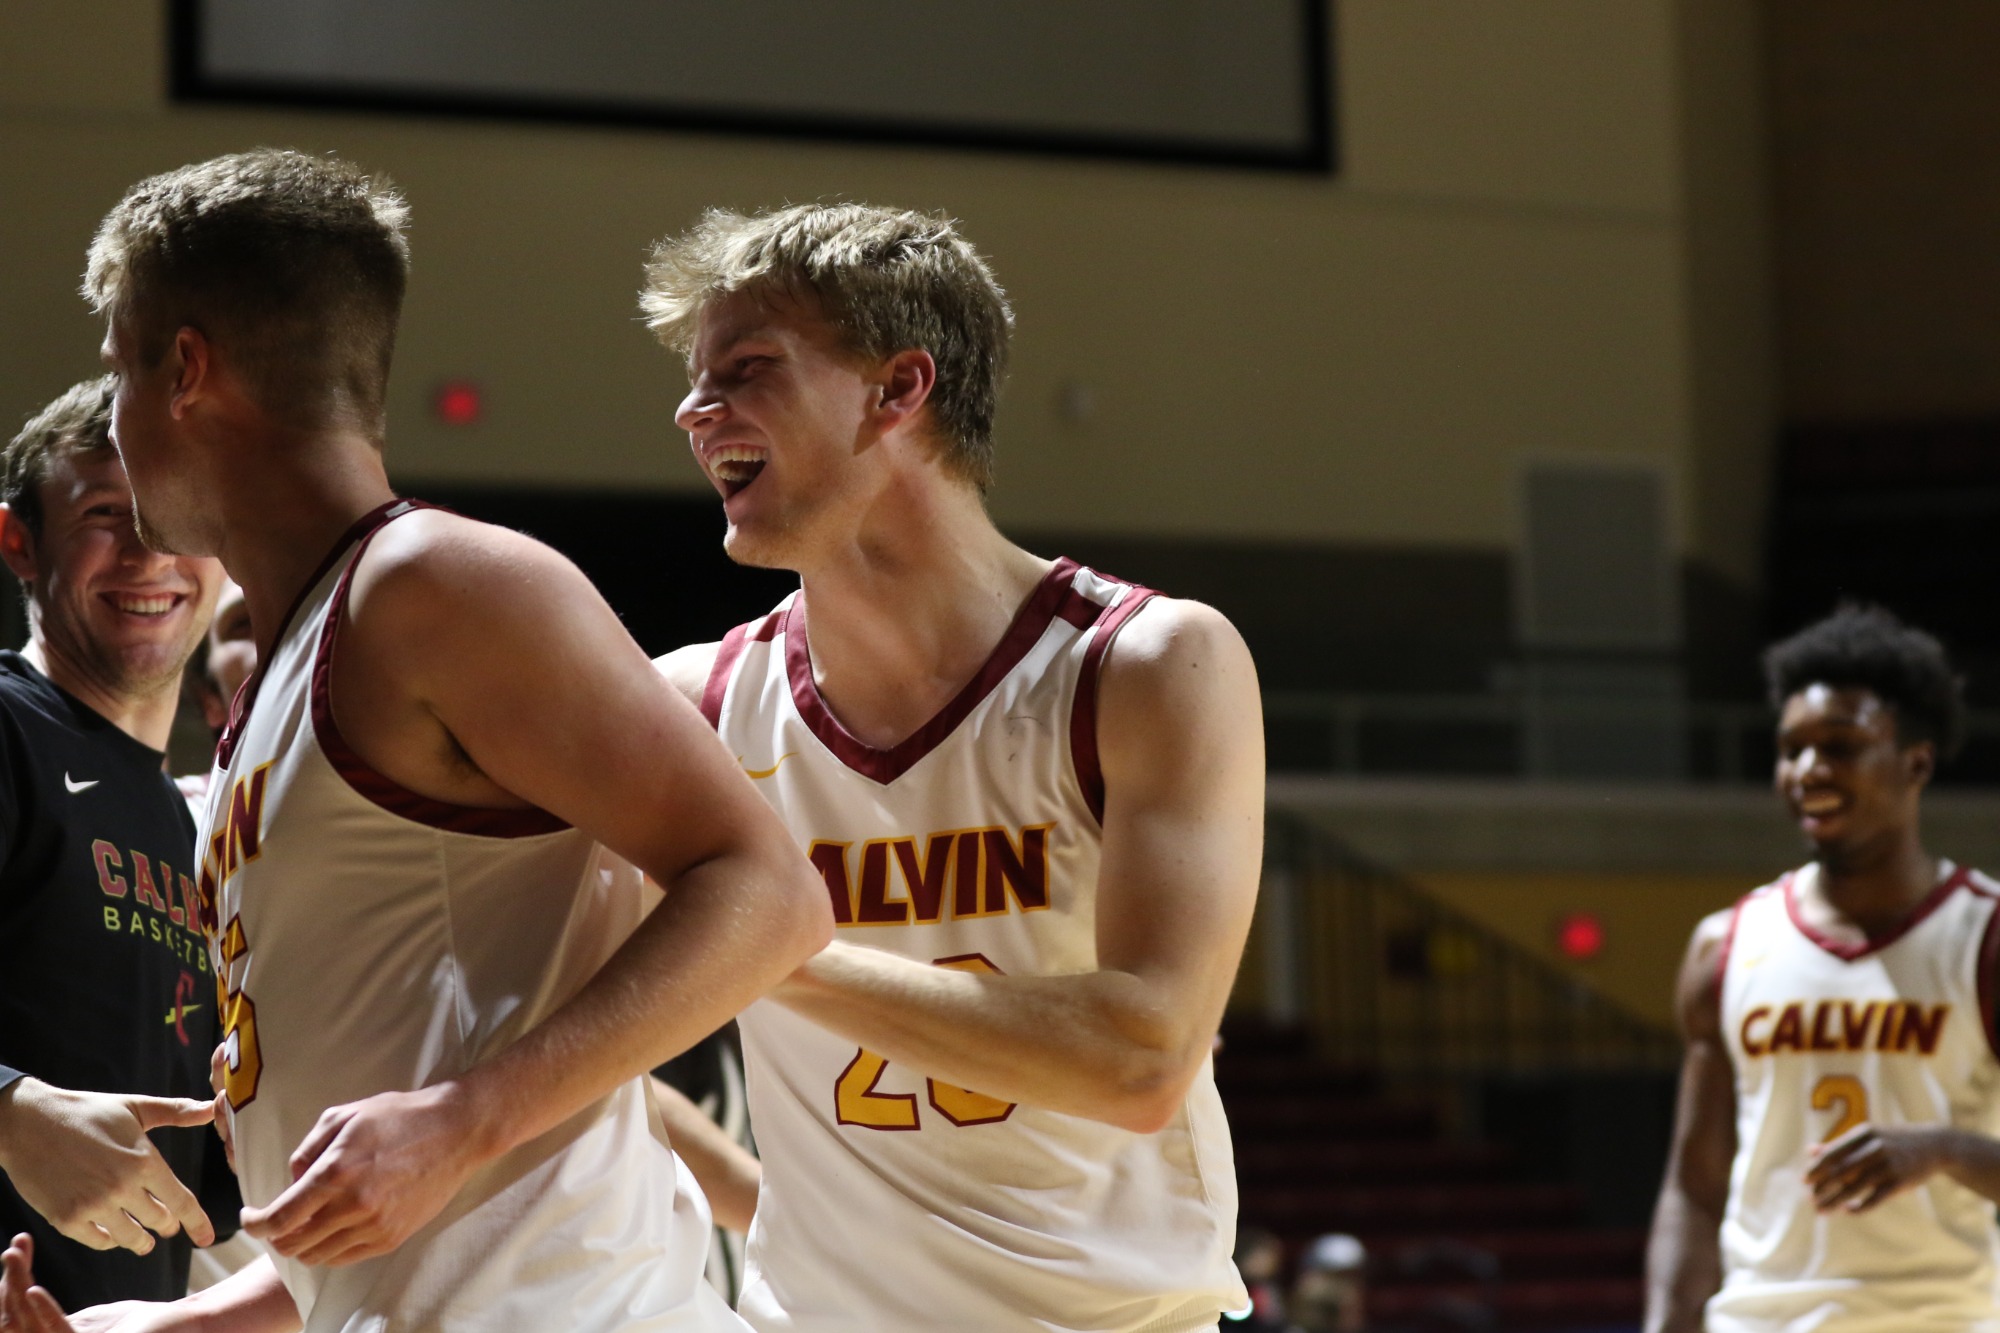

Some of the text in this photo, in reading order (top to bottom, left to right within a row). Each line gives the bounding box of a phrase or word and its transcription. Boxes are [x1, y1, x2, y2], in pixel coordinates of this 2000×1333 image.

[806, 821, 1057, 929] ALVIN
[1740, 1000, 1951, 1058] CALVIN
[1811, 1074, 1868, 1145] 2
